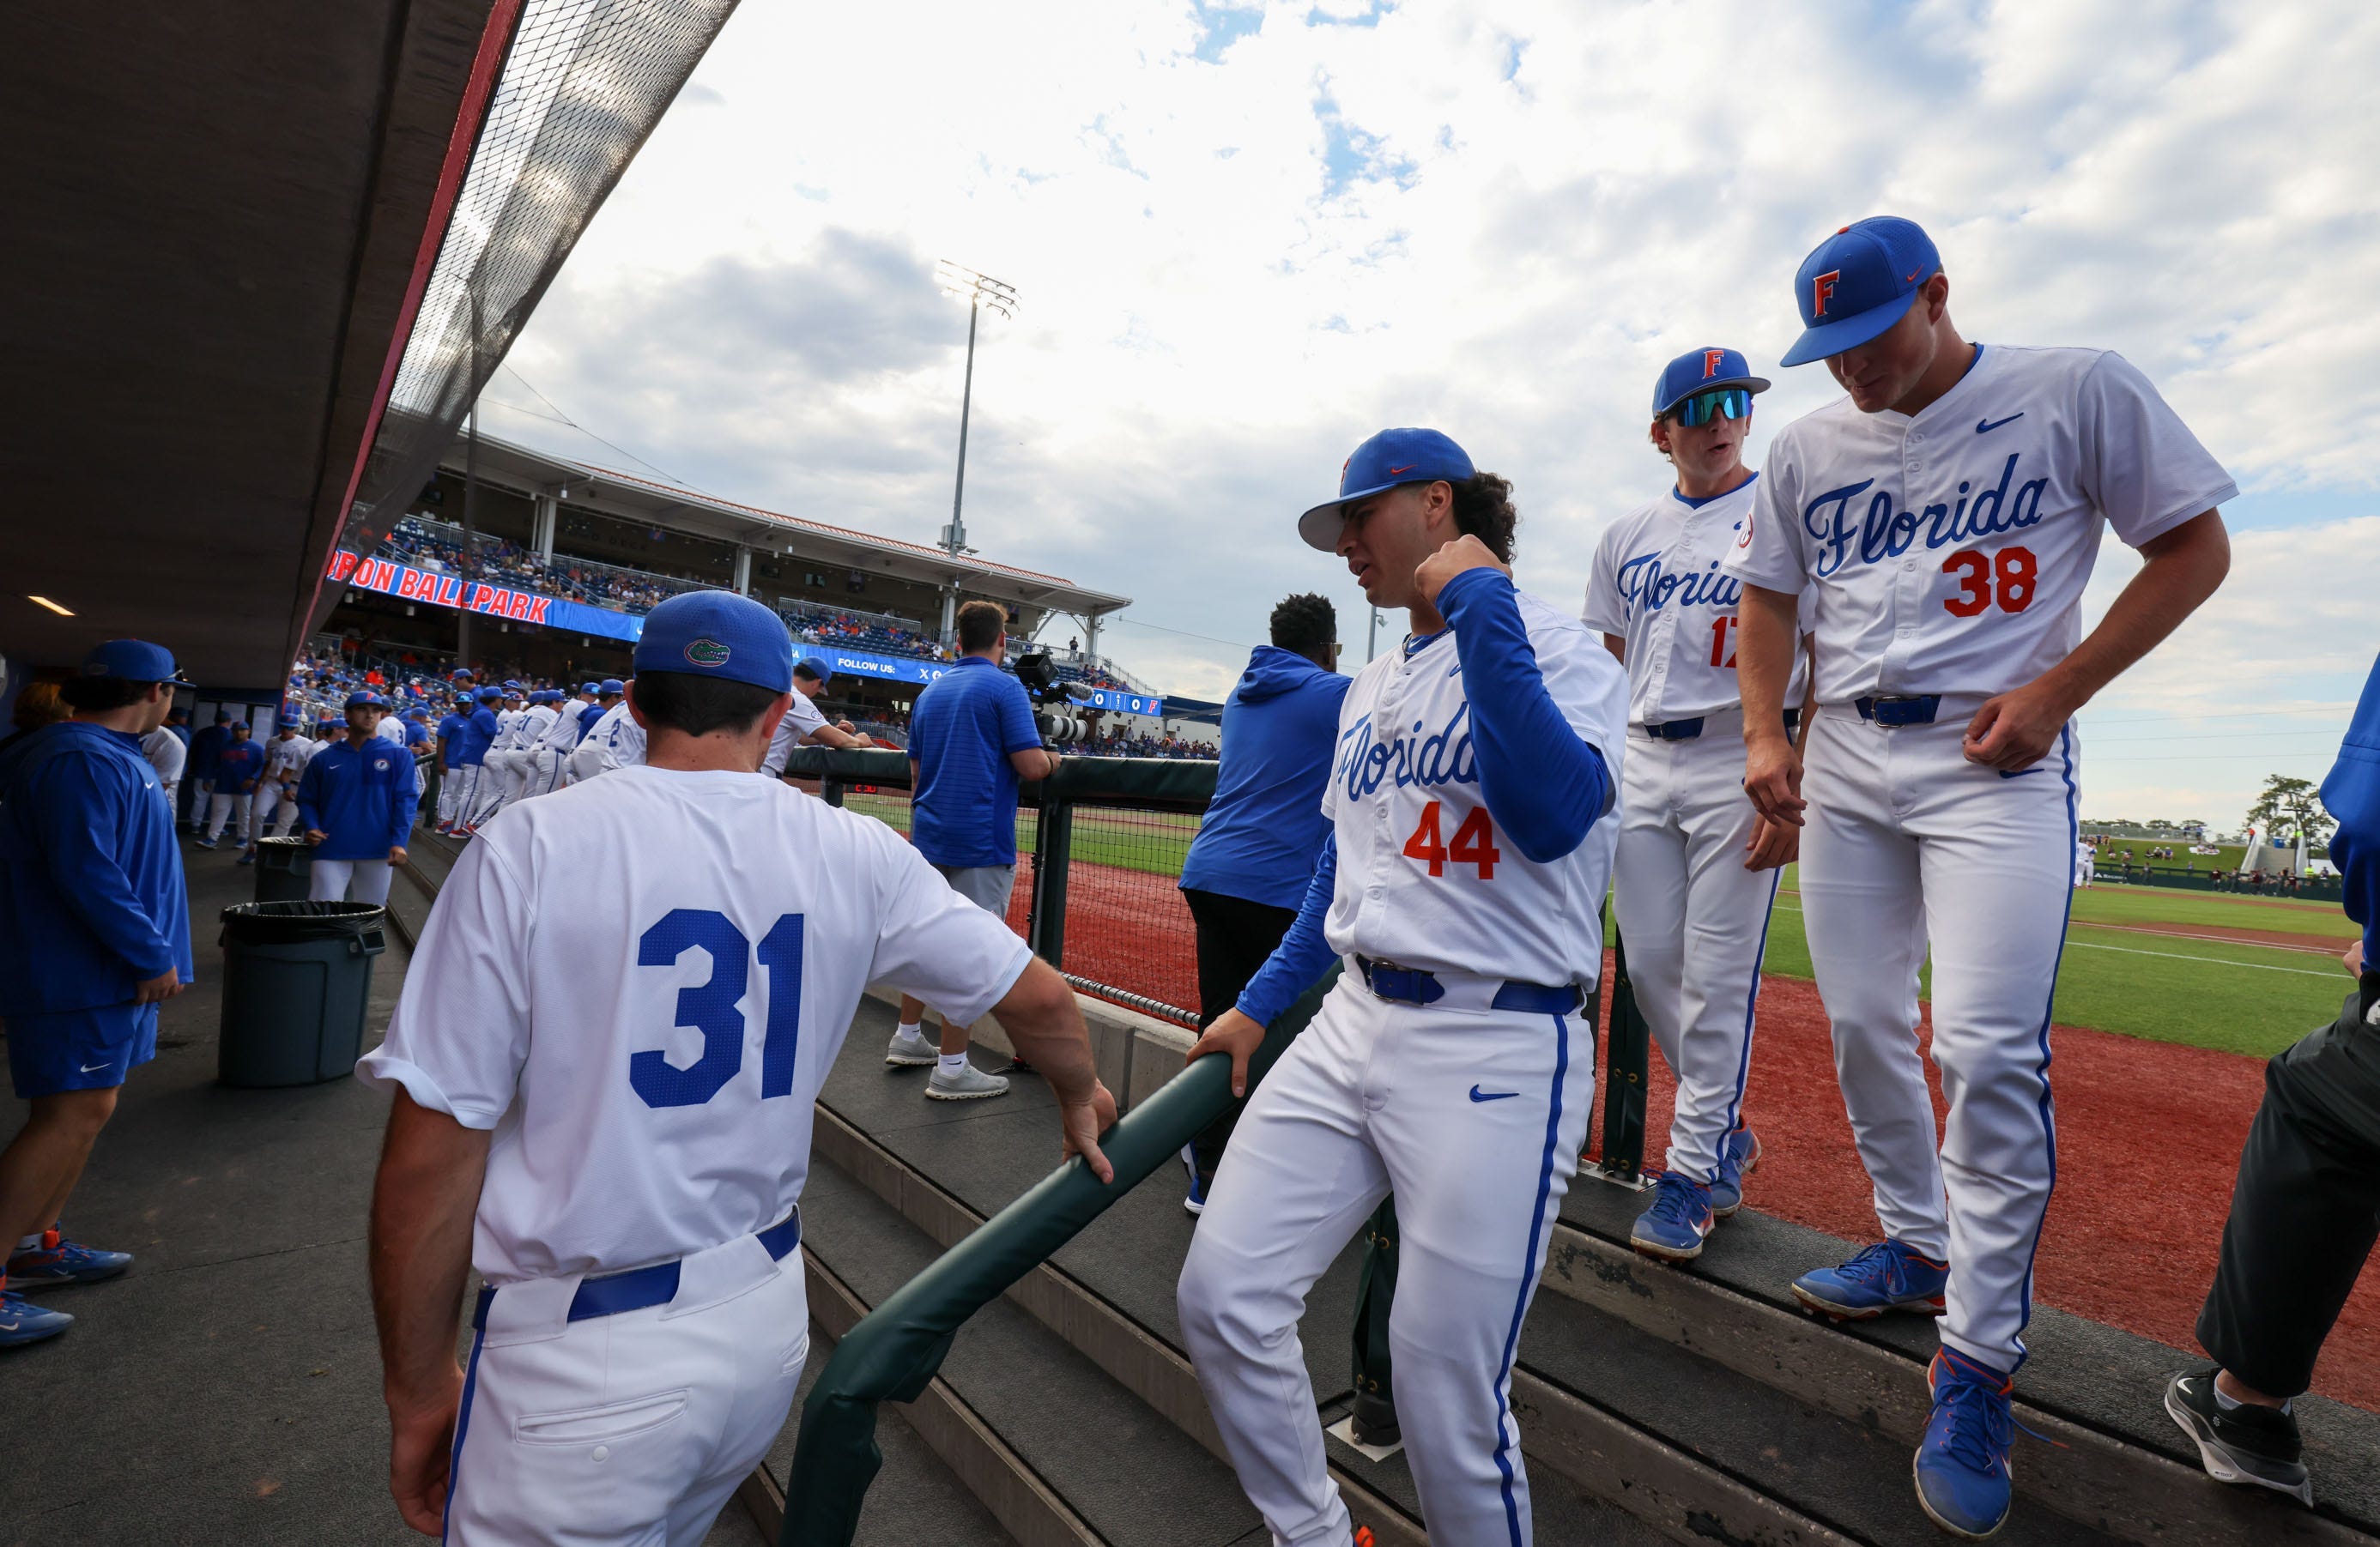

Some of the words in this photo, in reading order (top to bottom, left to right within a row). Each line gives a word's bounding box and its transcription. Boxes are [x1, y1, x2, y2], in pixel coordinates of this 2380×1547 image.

[1813, 269, 1840, 318] F
[1702, 349, 1724, 379] F
[1804, 453, 2049, 577] Florida
[395, 570, 552, 625] BALLPARK
[1941, 546, 2038, 618] 38
[838, 657, 878, 673] FOLLOW
[880, 664, 896, 674] US:
[516, 714, 533, 732] 21
[1094, 693, 1105, 706] 0
[1131, 698, 1141, 710] 0
[1402, 801, 1500, 880] 44
[629, 908, 804, 1109] 31
